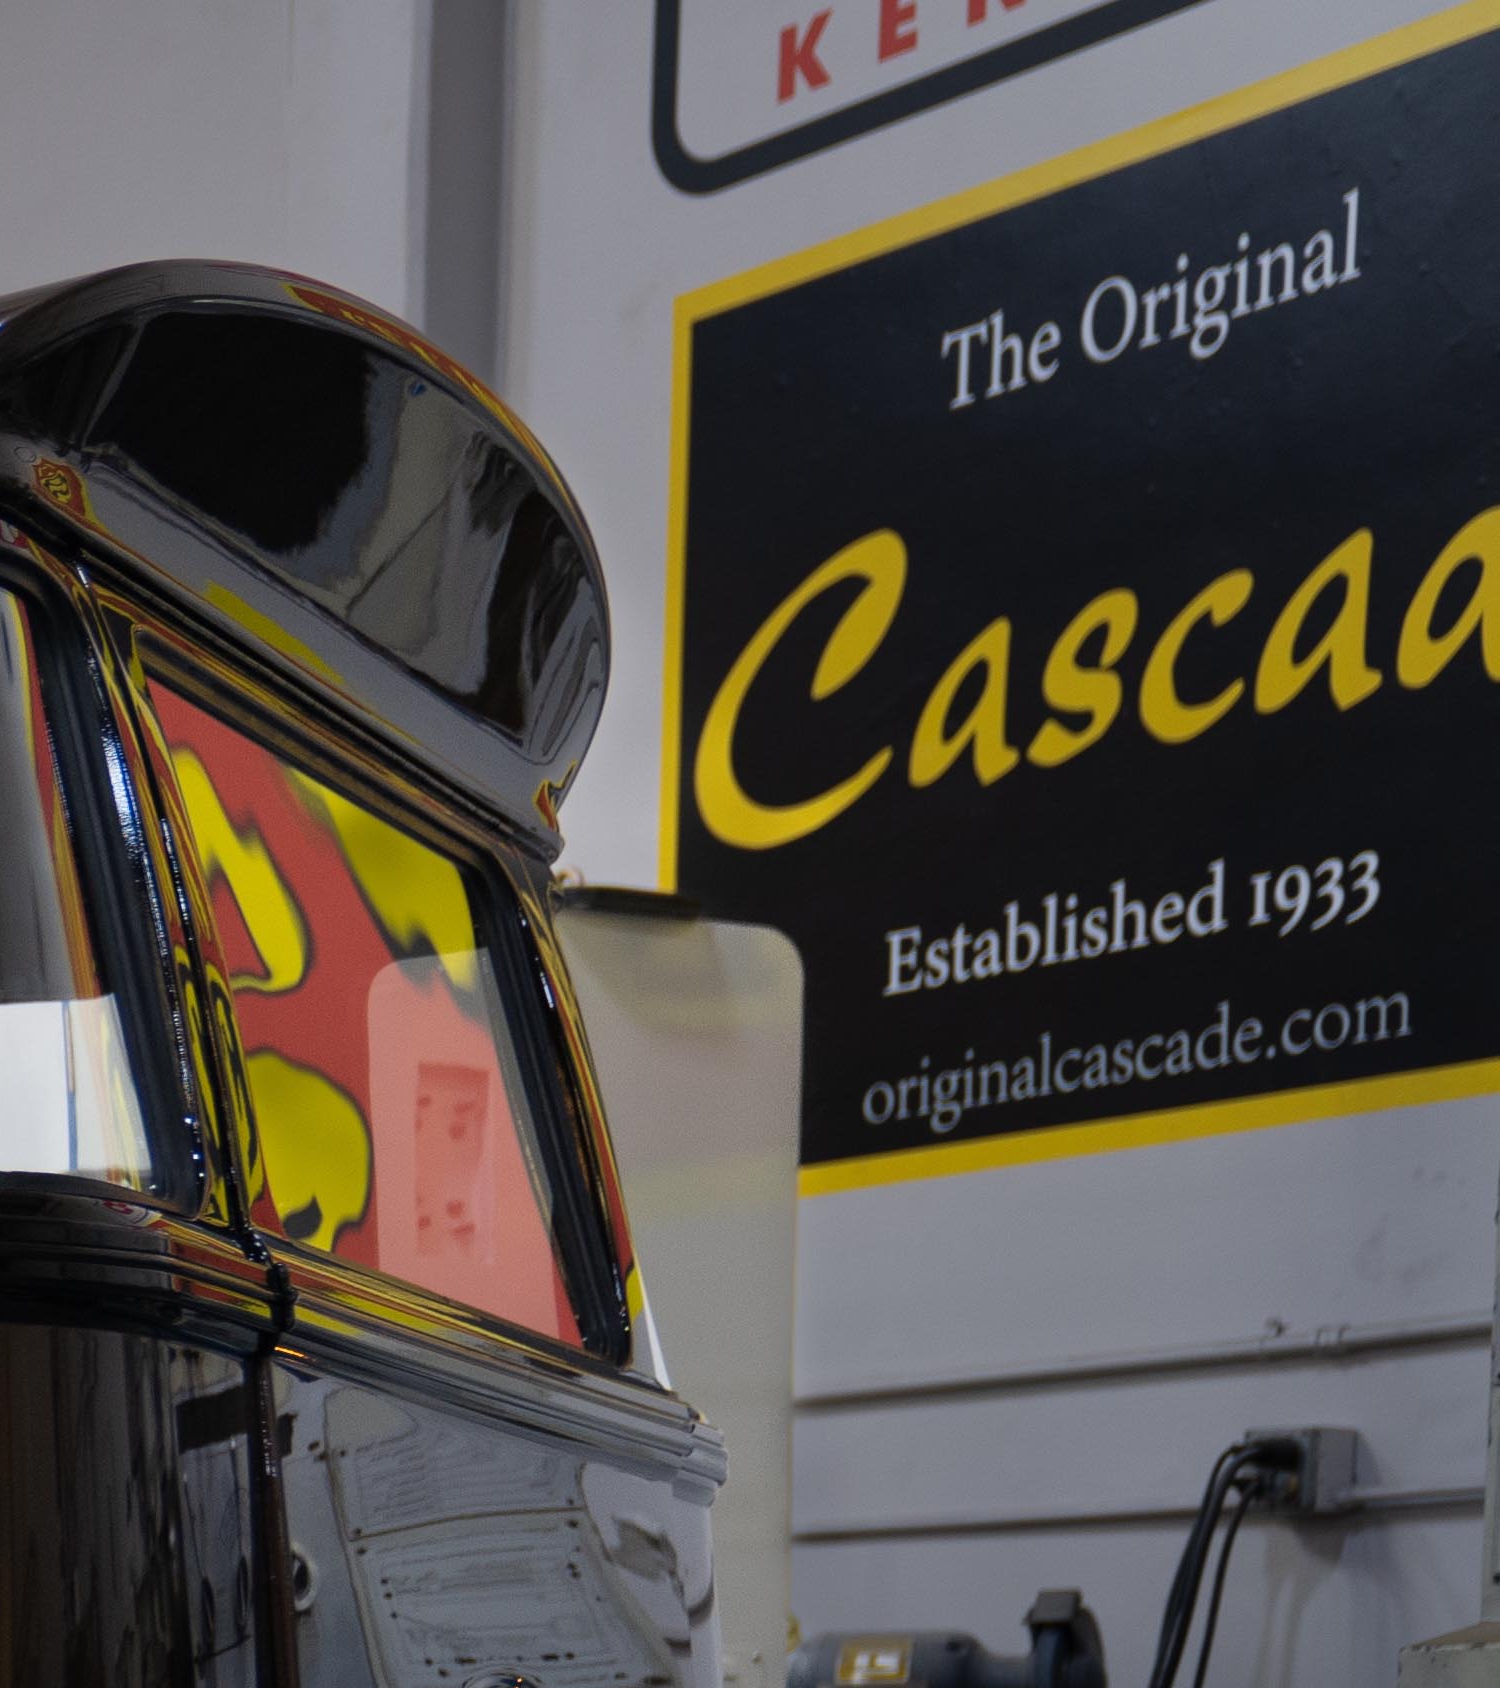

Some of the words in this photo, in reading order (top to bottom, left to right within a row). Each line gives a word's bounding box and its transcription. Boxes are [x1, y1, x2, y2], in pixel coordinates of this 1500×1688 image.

[941, 309, 1061, 409] The
[1080, 186, 1362, 361] Original
[883, 859, 1228, 996] Established
[1249, 851, 1381, 936] 1933
[862, 991, 1413, 1133] originalcascade.com
